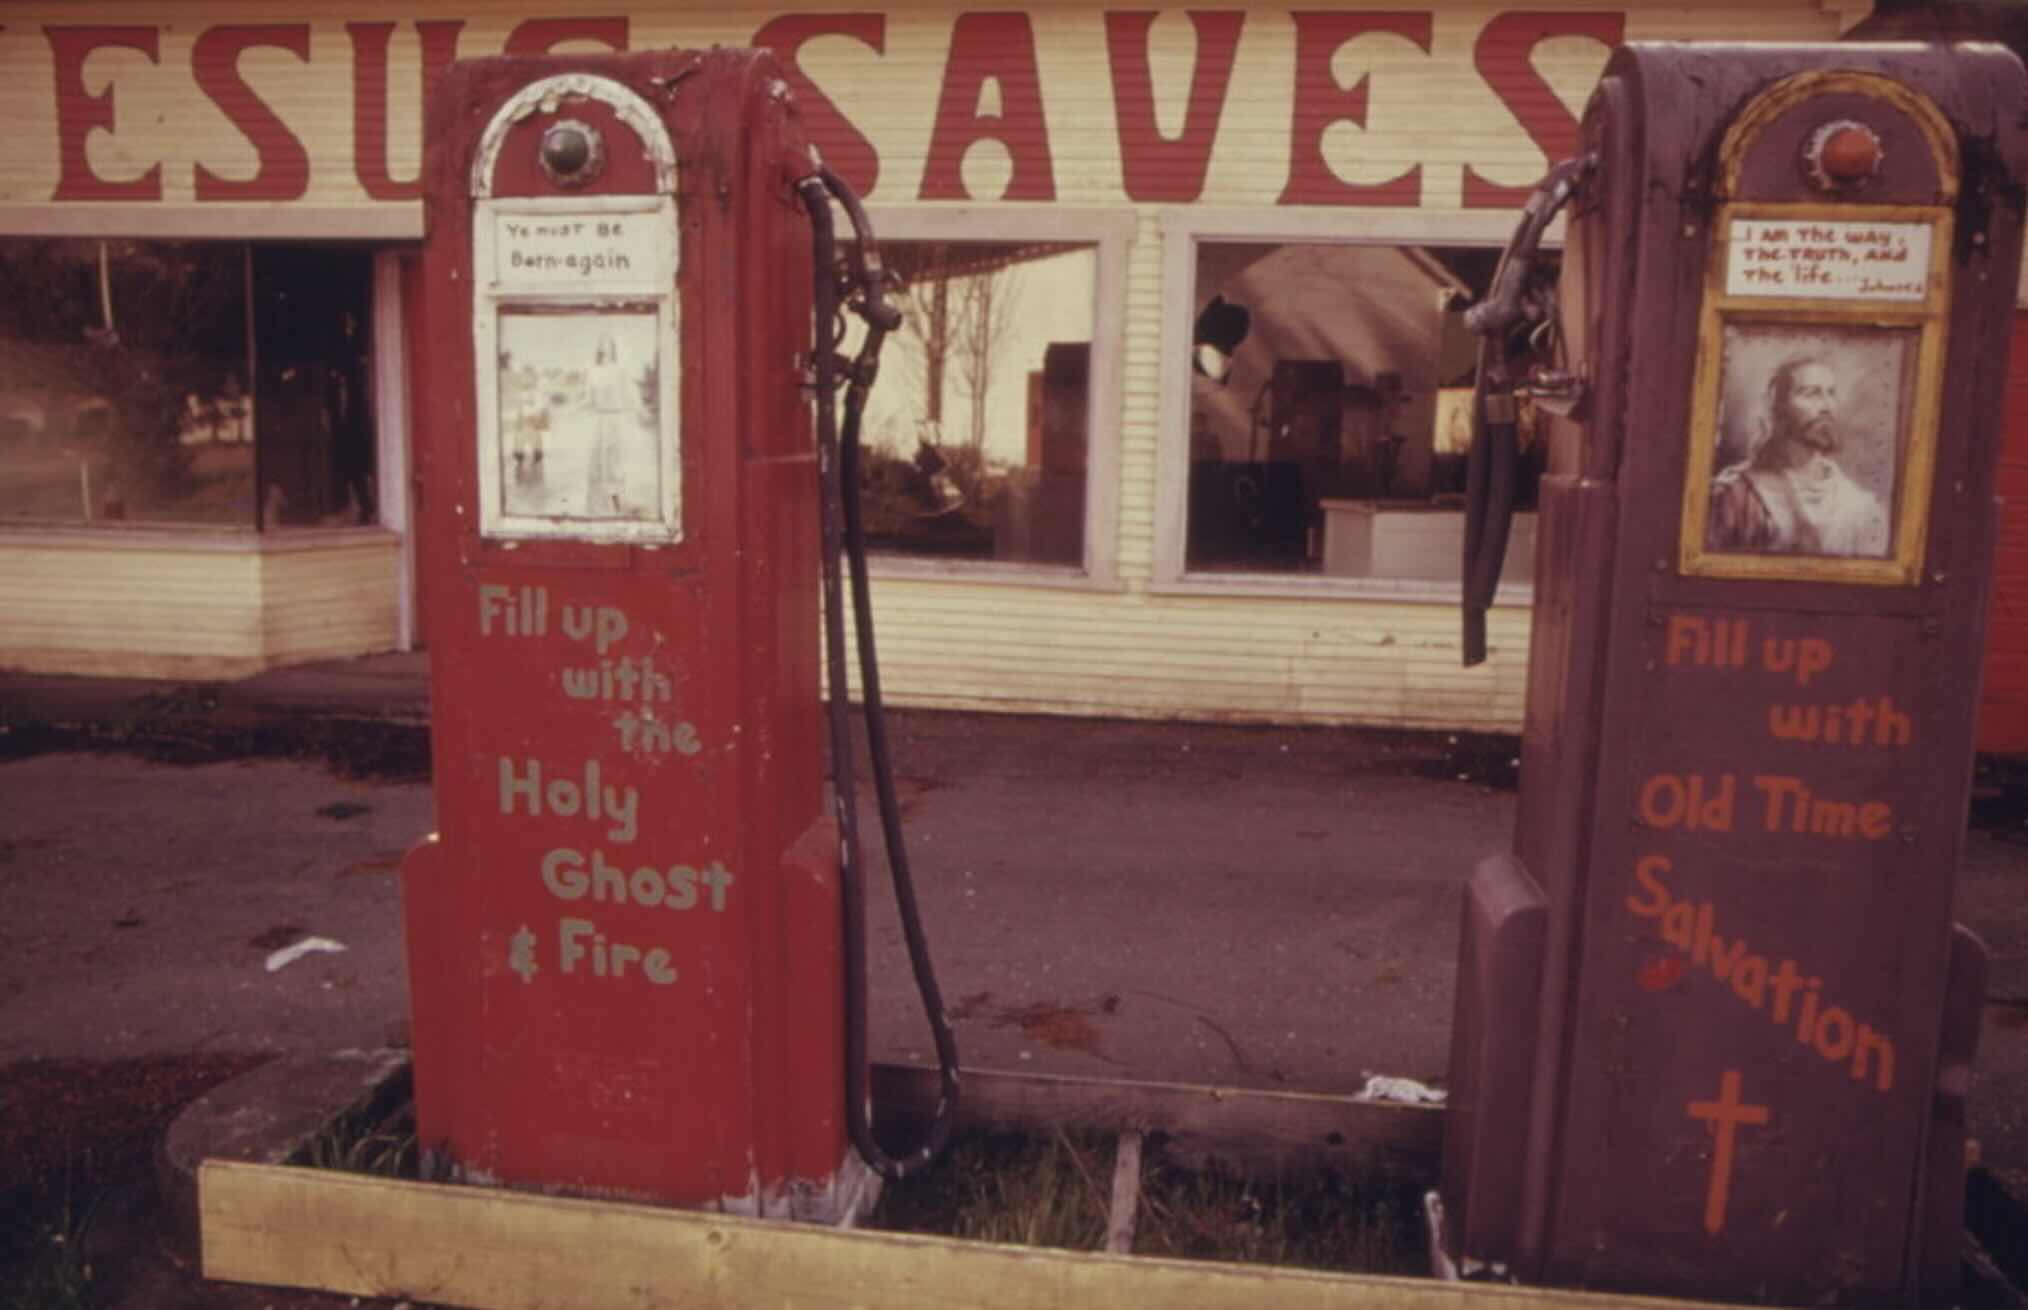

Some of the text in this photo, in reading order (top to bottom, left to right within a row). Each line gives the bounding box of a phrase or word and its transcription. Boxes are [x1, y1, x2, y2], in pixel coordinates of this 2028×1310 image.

[42, 10, 1626, 209] ESU SAVES
[1745, 226, 1752, 242] I
[479, 585, 629, 654] Fill up
[1666, 615, 1833, 686] Fill up
[562, 656, 673, 701] with
[613, 706, 701, 753] the
[1769, 696, 1912, 746] with
[499, 757, 639, 843] Holy
[1639, 773, 1892, 840] Old Time
[541, 847, 734, 912] Ghost
[508, 917, 678, 986] & Fire
[1624, 855, 1896, 1092] Salvation
